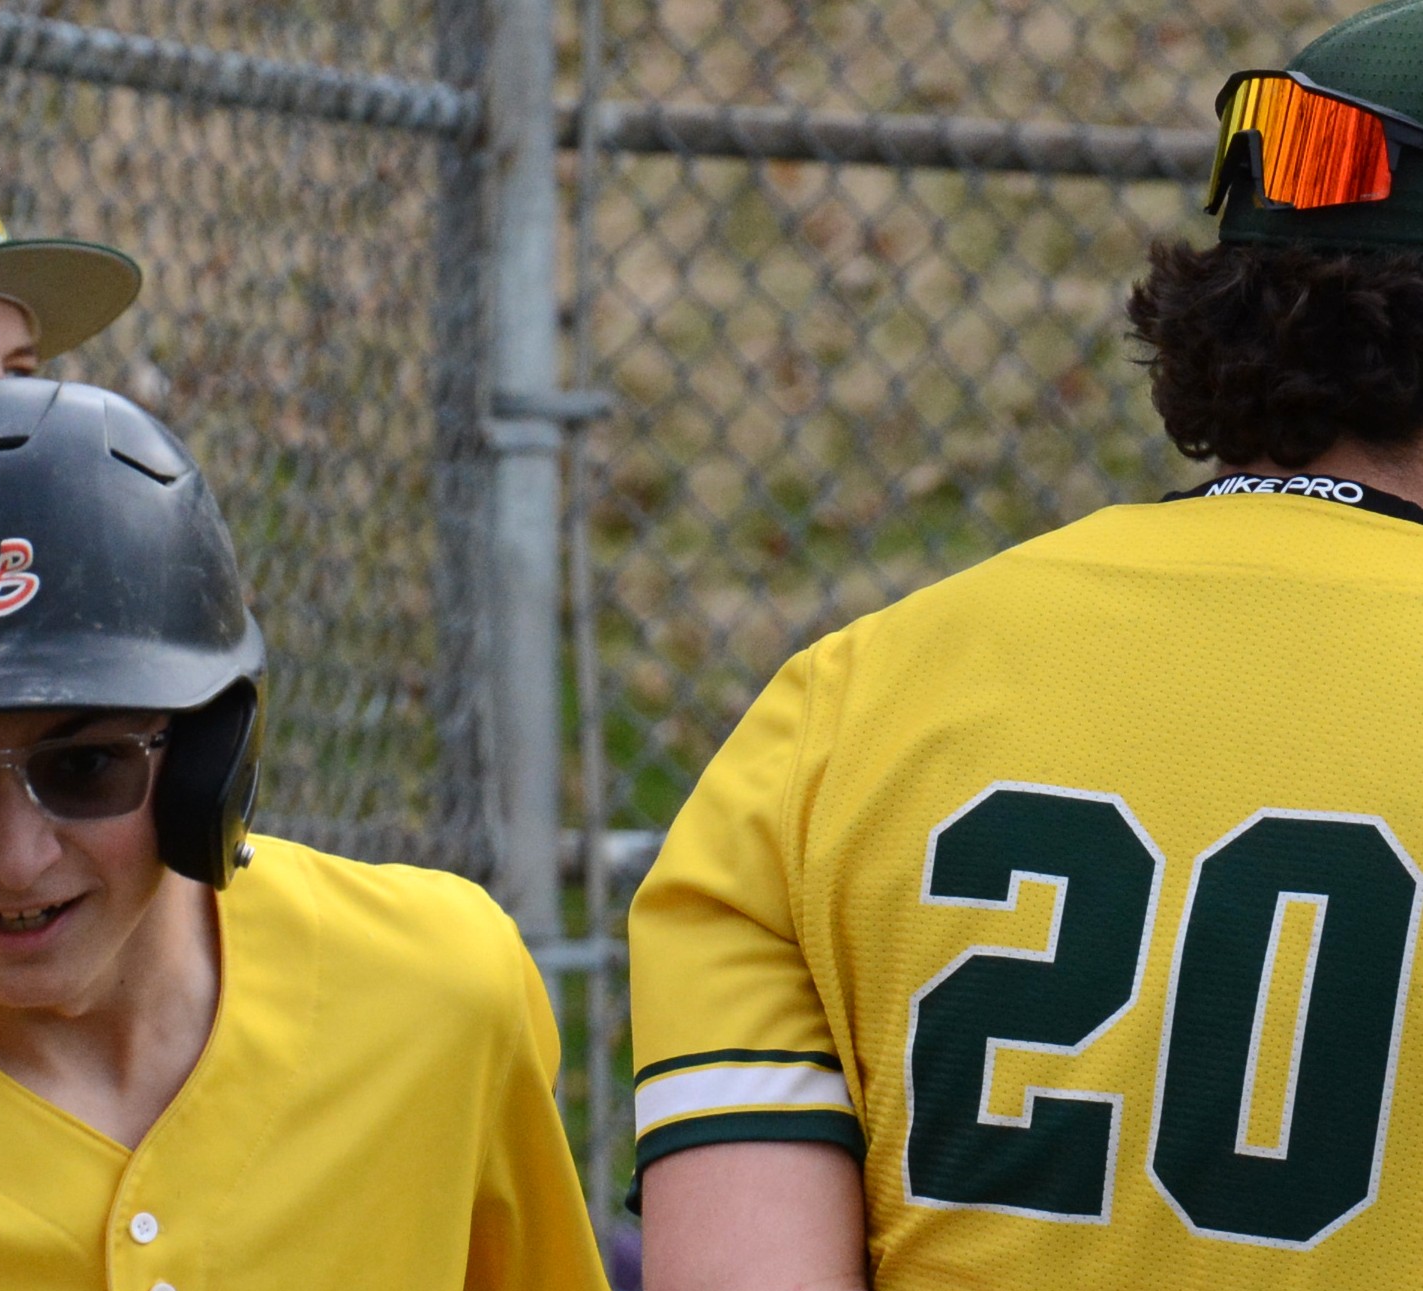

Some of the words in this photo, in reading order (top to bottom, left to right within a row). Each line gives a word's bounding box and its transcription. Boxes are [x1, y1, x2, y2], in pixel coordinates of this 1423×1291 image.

[1205, 476, 1282, 497] NIKE
[1281, 476, 1364, 503] PRO
[903, 780, 1423, 1252] 20
